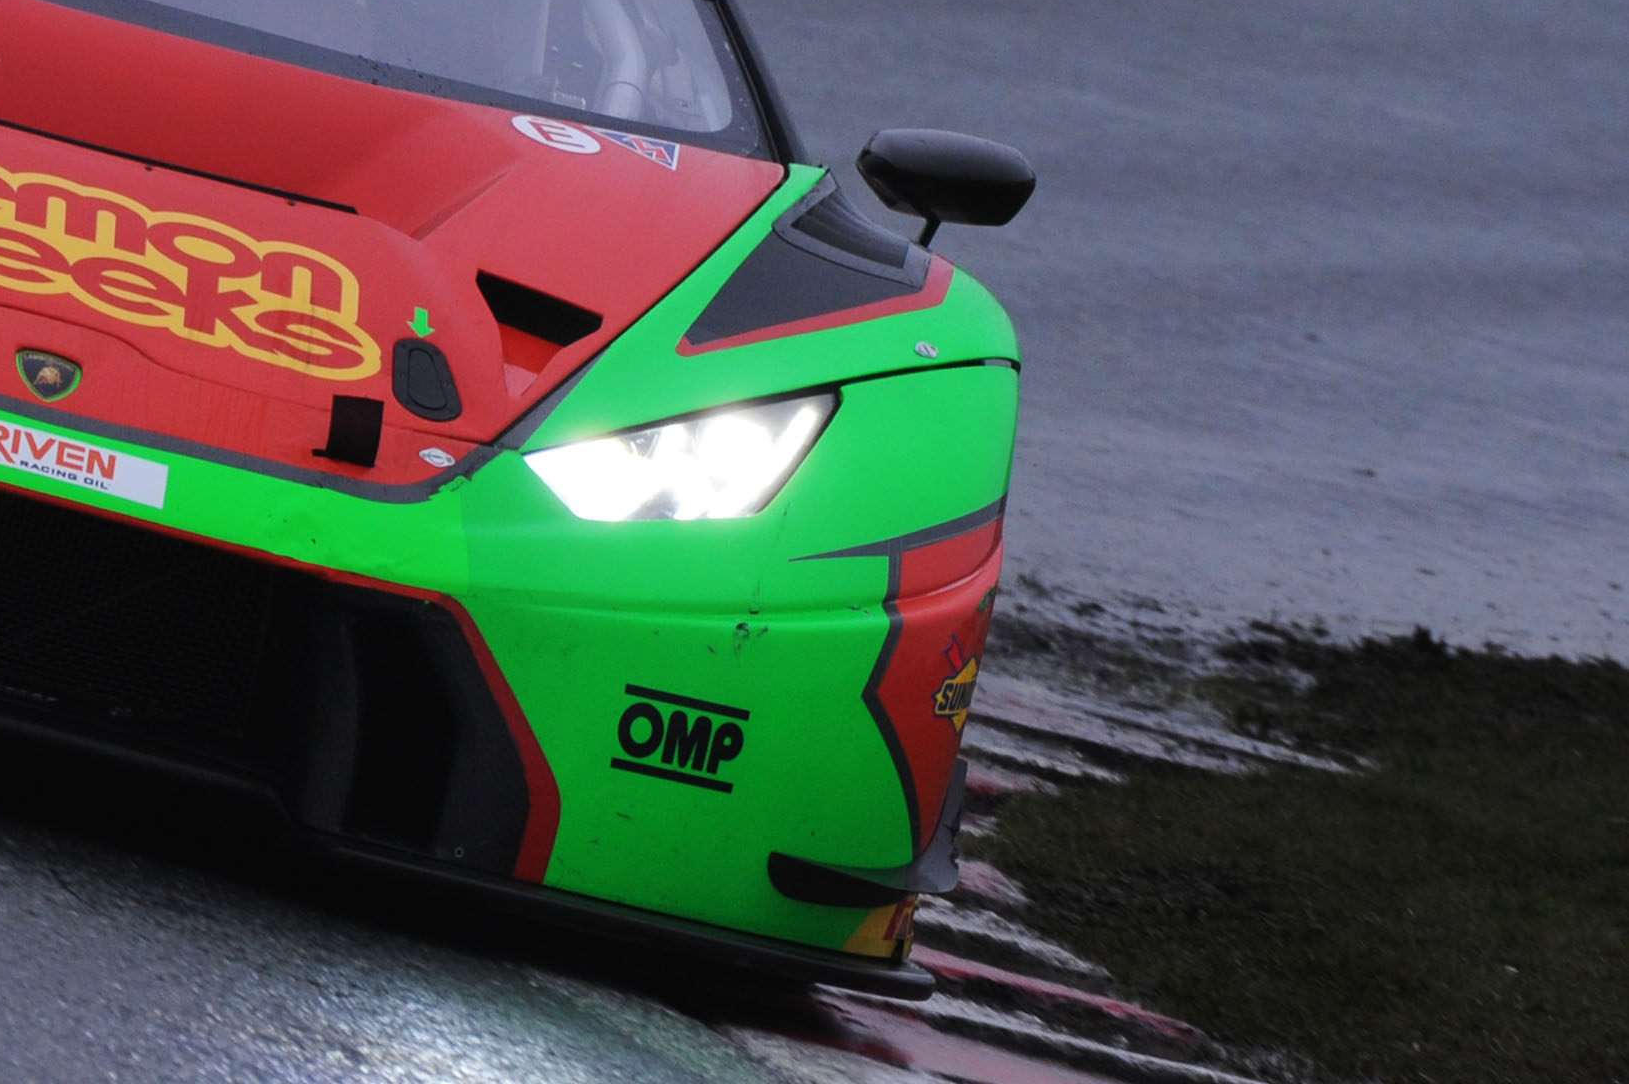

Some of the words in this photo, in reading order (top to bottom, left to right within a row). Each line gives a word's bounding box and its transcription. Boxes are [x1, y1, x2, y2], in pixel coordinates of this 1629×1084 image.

[19, 460, 78, 482] RACING
[83, 476, 109, 490] OIL
[617, 700, 744, 776] OMP
